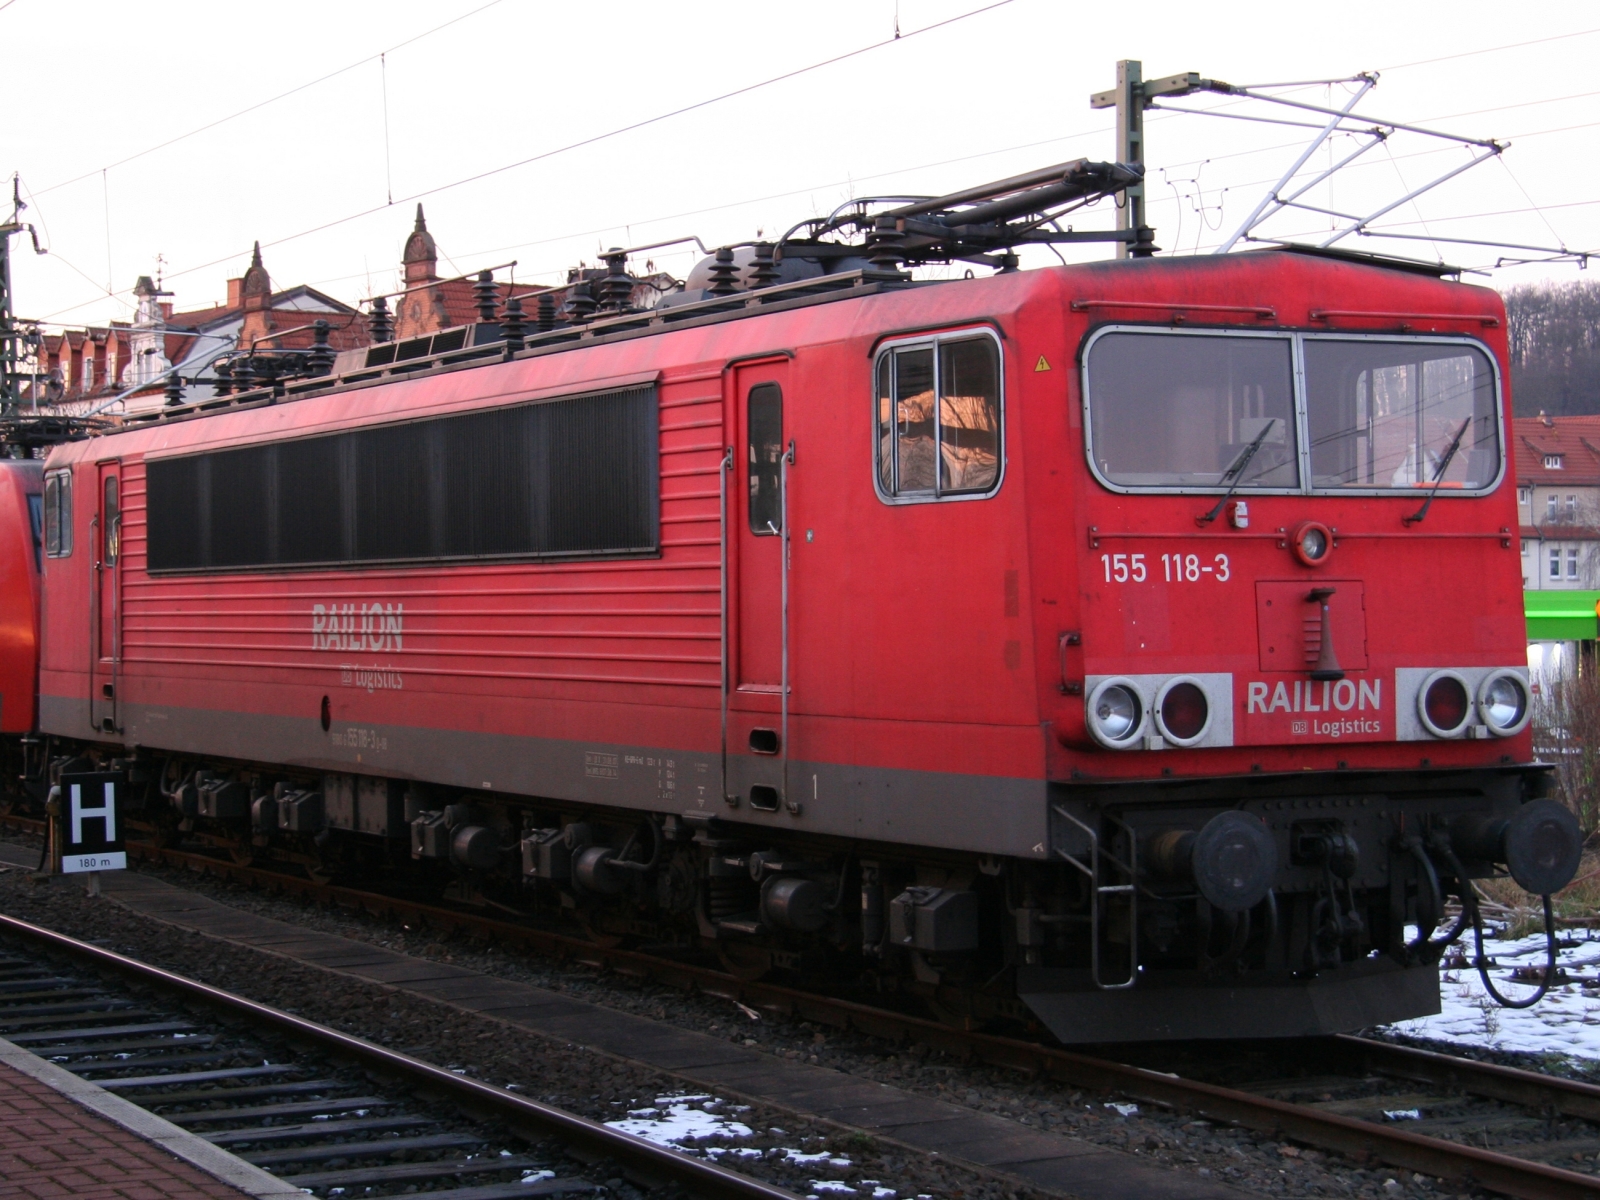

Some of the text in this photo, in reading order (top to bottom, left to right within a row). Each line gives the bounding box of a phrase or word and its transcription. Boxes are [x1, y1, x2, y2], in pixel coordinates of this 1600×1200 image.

[1101, 553, 1230, 583] 155 118-3
[311, 602, 404, 652] RAILION
[355, 663, 404, 694] Logistics
[1247, 679, 1381, 714] RAILION
[1292, 717, 1381, 737] DB Logistics
[71, 782, 116, 844] H
[80, 858, 111, 868] 180 m
